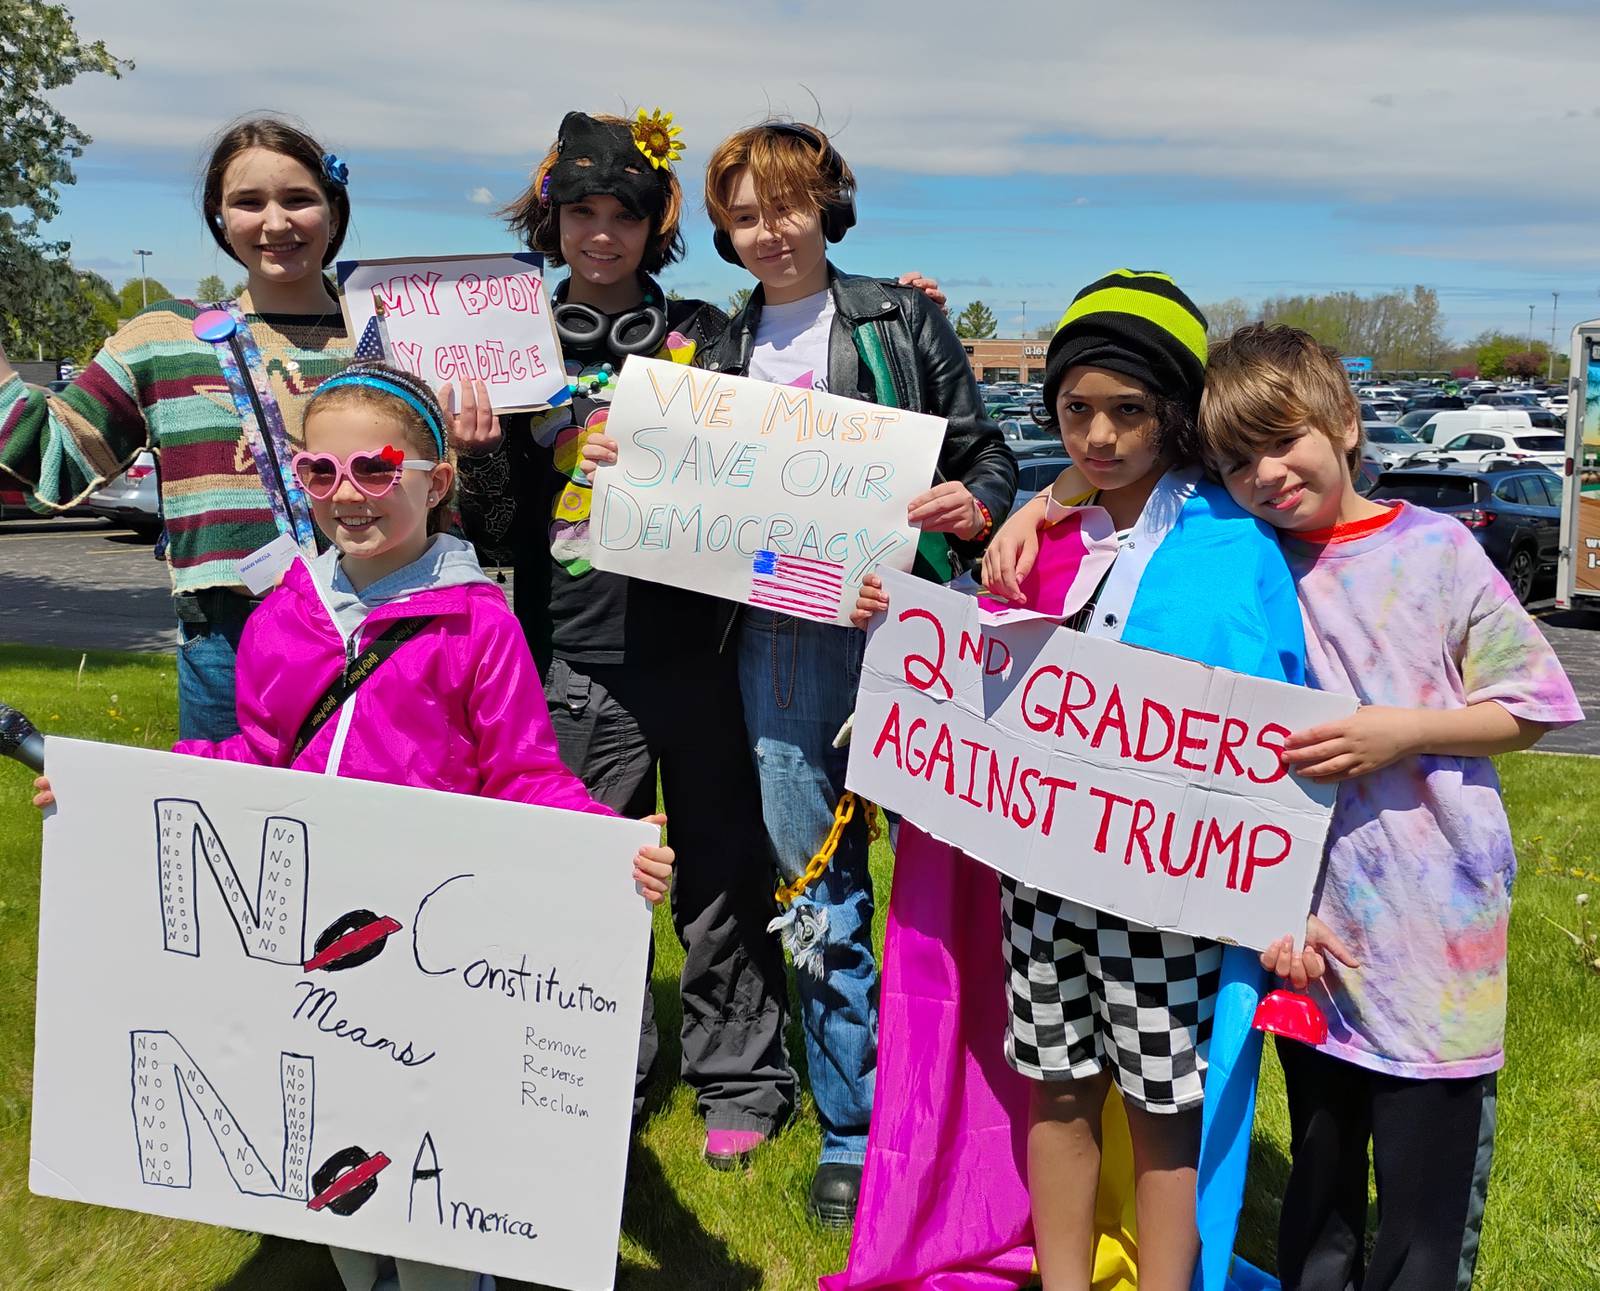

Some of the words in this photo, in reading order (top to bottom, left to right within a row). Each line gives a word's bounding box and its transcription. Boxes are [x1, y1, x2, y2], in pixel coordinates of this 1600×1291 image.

[370, 272, 442, 317] MY
[456, 273, 542, 315] BODY
[435, 340, 546, 384] CHOICE
[623, 426, 767, 488] SAVE
[600, 484, 909, 589] DEMOCRACY
[1021, 665, 1293, 786] GRADERS
[873, 702, 1077, 837] AGAINST
[1090, 787, 1293, 893] TRUMP
[414, 874, 618, 1016] Constitution
[293, 981, 436, 1066] Means
[525, 1025, 587, 1060] Remove
[521, 1081, 589, 1118] Reclaim
[523, 1054, 584, 1087] Reverse
[409, 1131, 539, 1240] America
